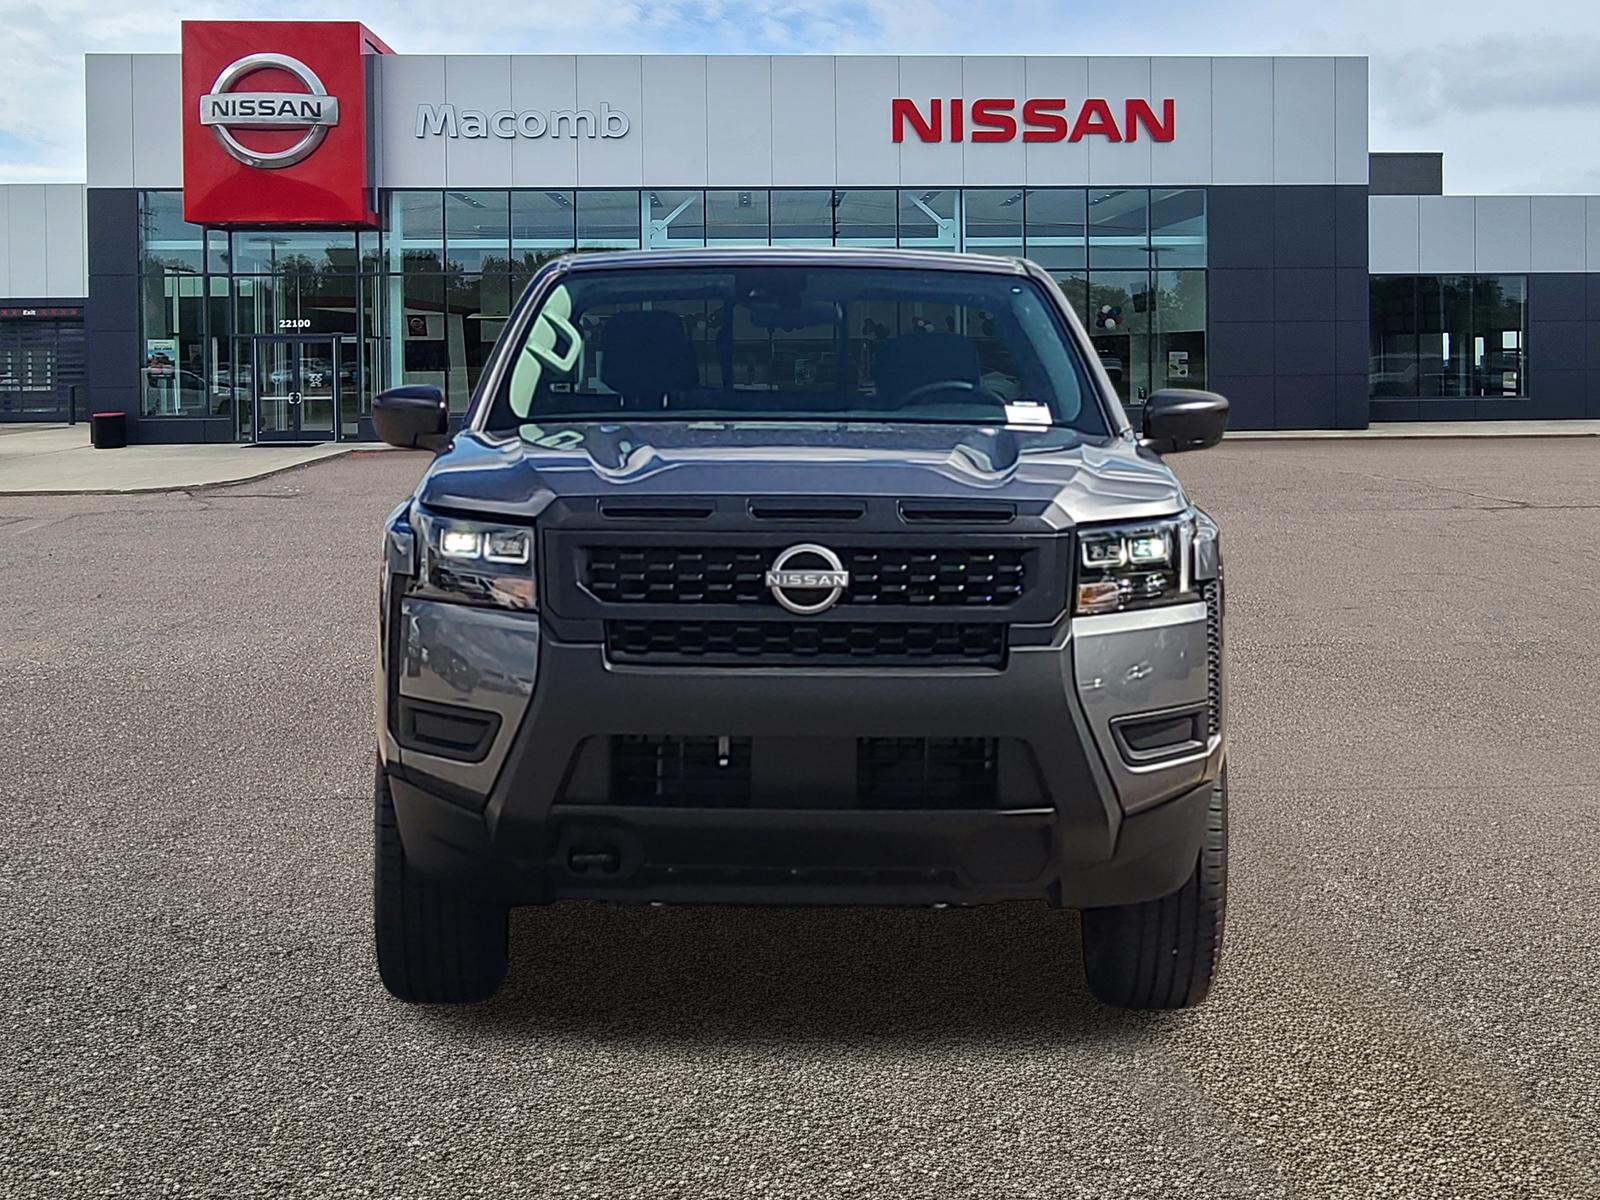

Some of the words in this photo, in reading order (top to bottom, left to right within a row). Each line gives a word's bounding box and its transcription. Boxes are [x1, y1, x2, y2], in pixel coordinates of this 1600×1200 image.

[212, 100, 322, 117] NISSAN
[415, 102, 630, 139] Macomb
[892, 98, 1175, 143] NISSAN
[279, 319, 311, 328] 22100
[767, 574, 846, 586] NISSAN
